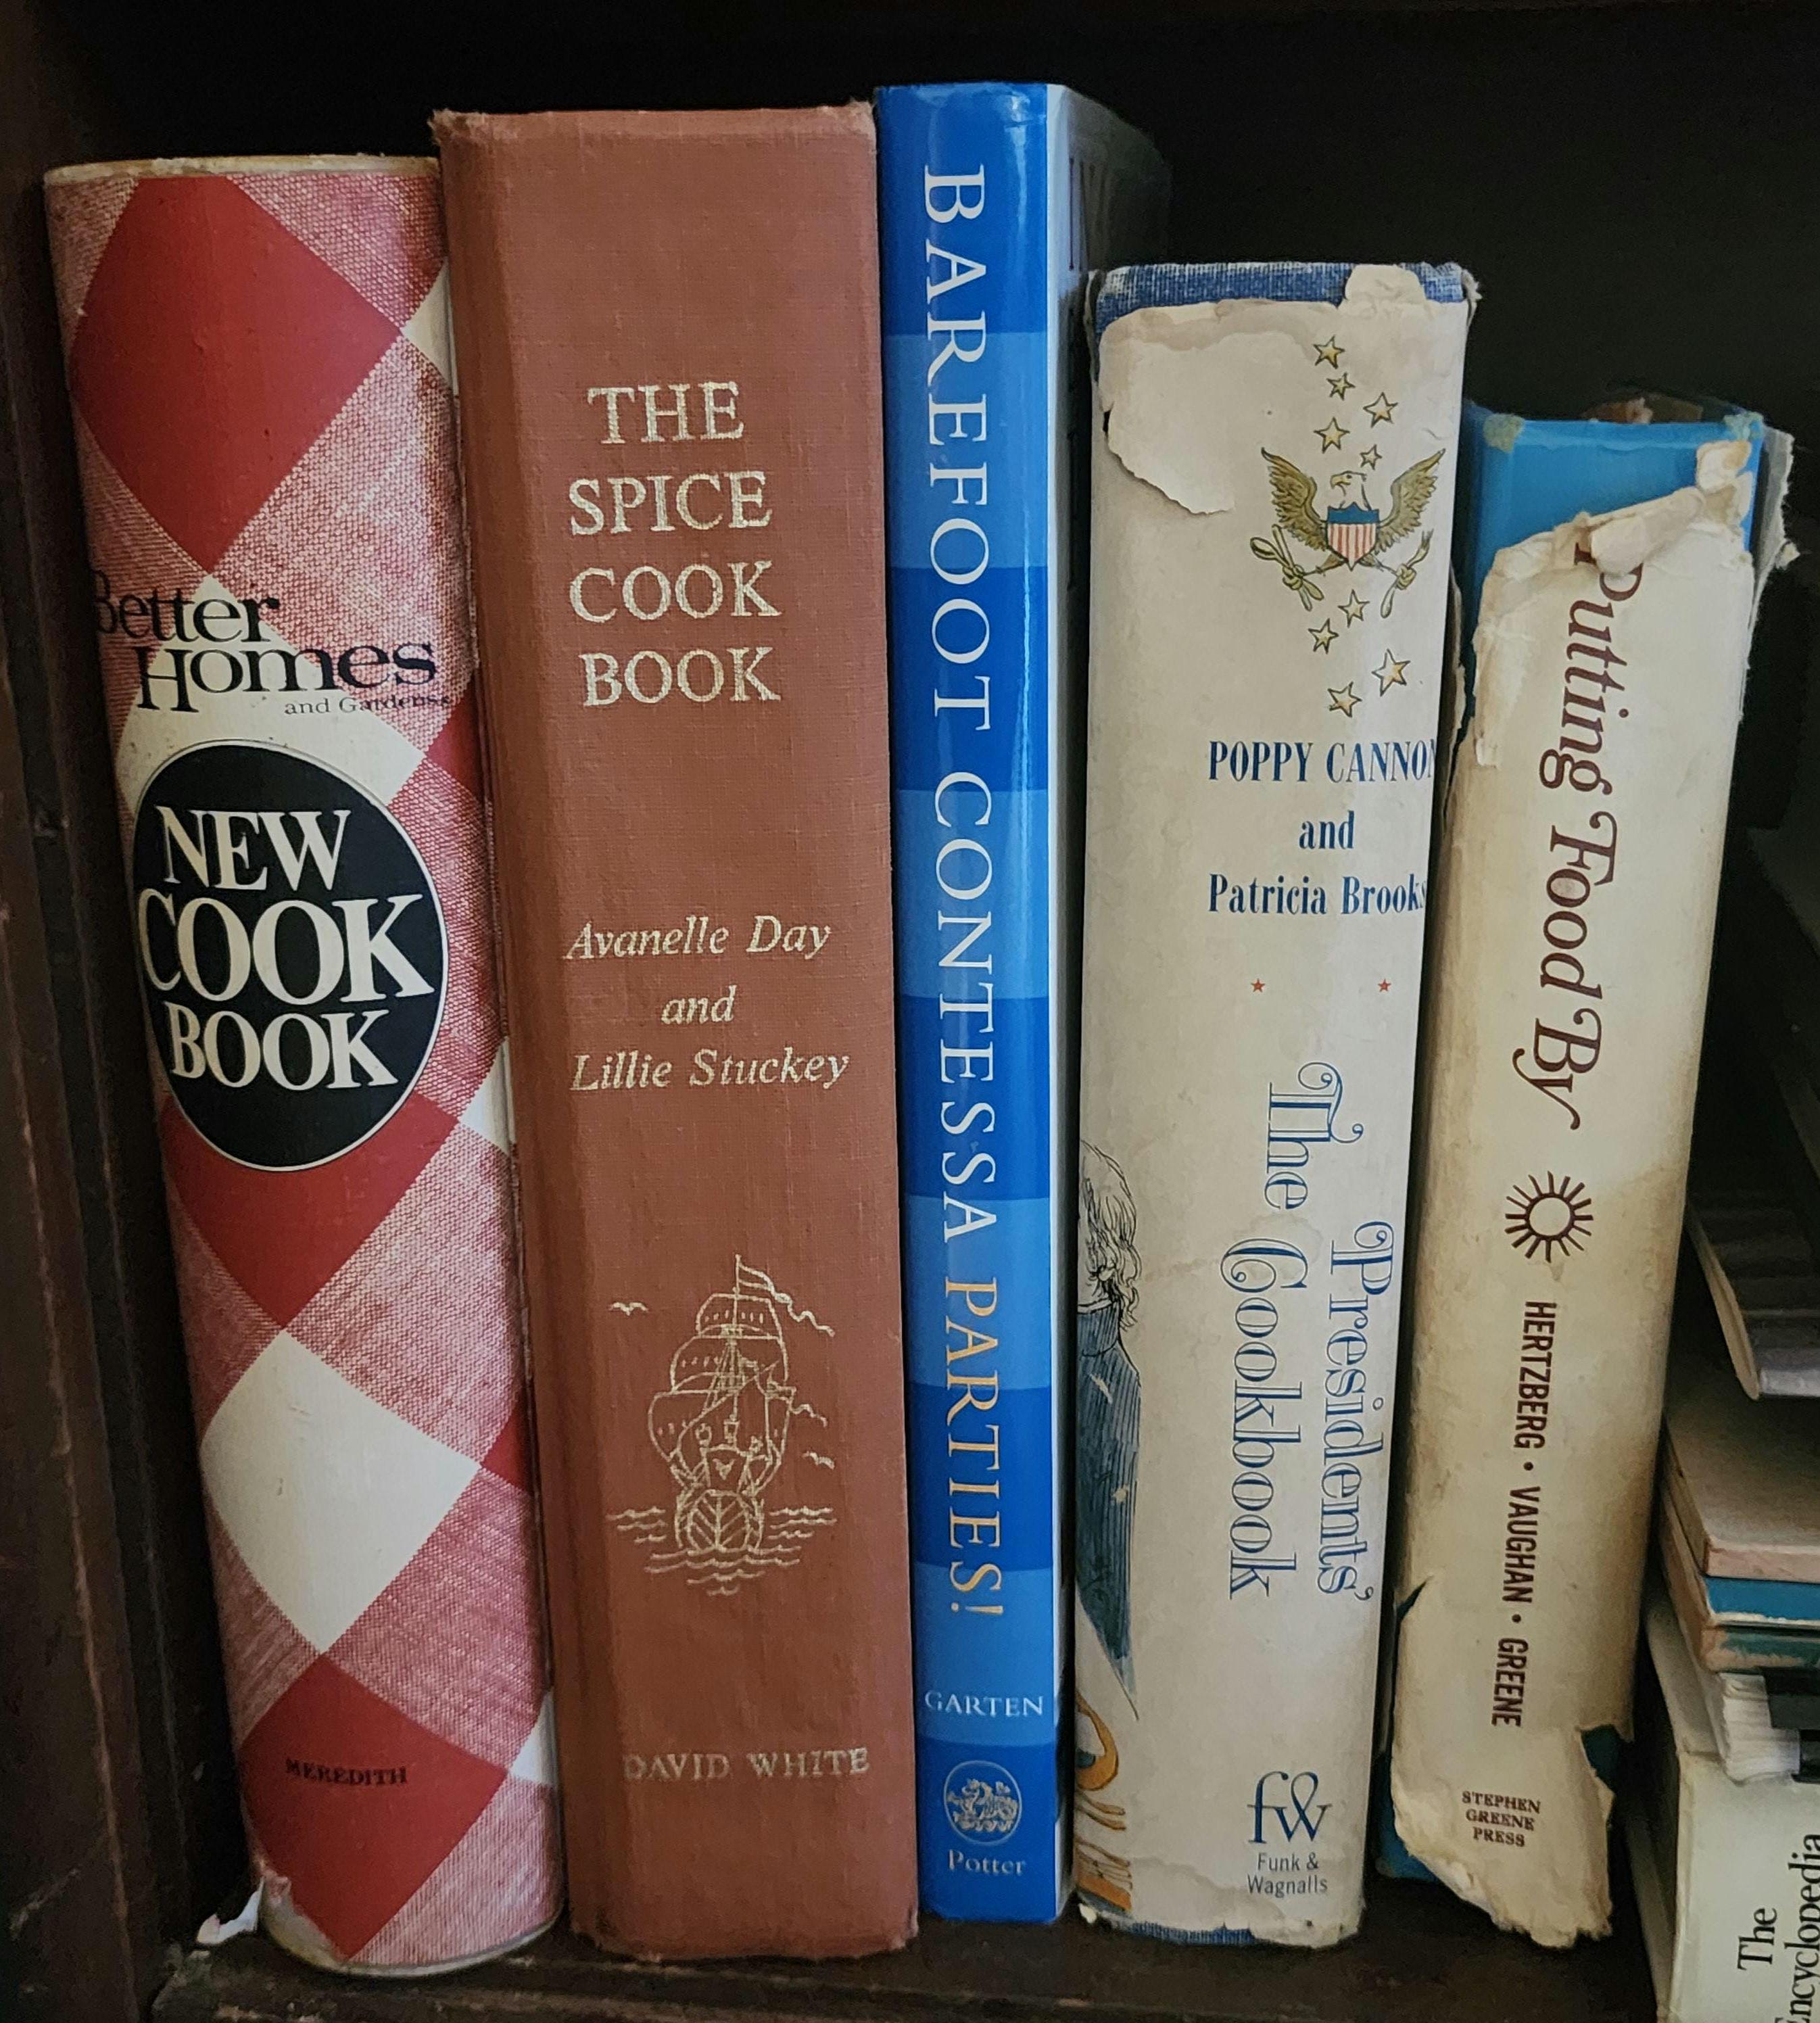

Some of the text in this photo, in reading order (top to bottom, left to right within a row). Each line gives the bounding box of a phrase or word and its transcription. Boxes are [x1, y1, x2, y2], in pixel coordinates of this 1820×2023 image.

[587, 381, 744, 444] THE
[569, 471, 772, 536] SPICE
[569, 560, 782, 623] COOK
[137, 641, 436, 713] Homes
[578, 646, 781, 707] BOOK
[284, 698, 330, 715] and
[1208, 741, 1313, 782] POPPY
[154, 806, 351, 891] NEW
[1299, 810, 1355, 849] and
[924, 164, 1003, 1615] BAREFOOT CONTESSA PARTIES!
[1208, 874, 1326, 915] Patricia
[1540, 811, 1618, 999] Food
[138, 888, 437, 1005] COOK
[563, 915, 831, 959] Avanelle Day
[661, 985, 737, 1025] and
[163, 1000, 399, 1091] BOOK
[570, 1047, 850, 1091] Lillie Stuckey
[1512, 1007, 1602, 1130] By
[1264, 1062, 1364, 1210] The
[1220, 1238, 1309, 1600] Cookbook
[1491, 1301, 1557, 1728] HERTZBERG VAUGHAN GREENE
[925, 1690, 1044, 1717] GARTEN
[285, 1758, 407, 1786] MEREDITH
[623, 1747, 870, 1781] DAVID WHITE
[1462, 1790, 1541, 1814] STEPHEN
[1466, 1809, 1535, 1831] GREENE
[949, 1849, 1026, 1876] Potter
[1258, 1852, 1318, 1872] Funk &
[1472, 1826, 1525, 1847] PRESS
[1247, 1874, 1328, 1899] Wagnalls
[1738, 1907, 1777, 1971] The
[1775, 1834, 1820, 2023] ncyclopedia
